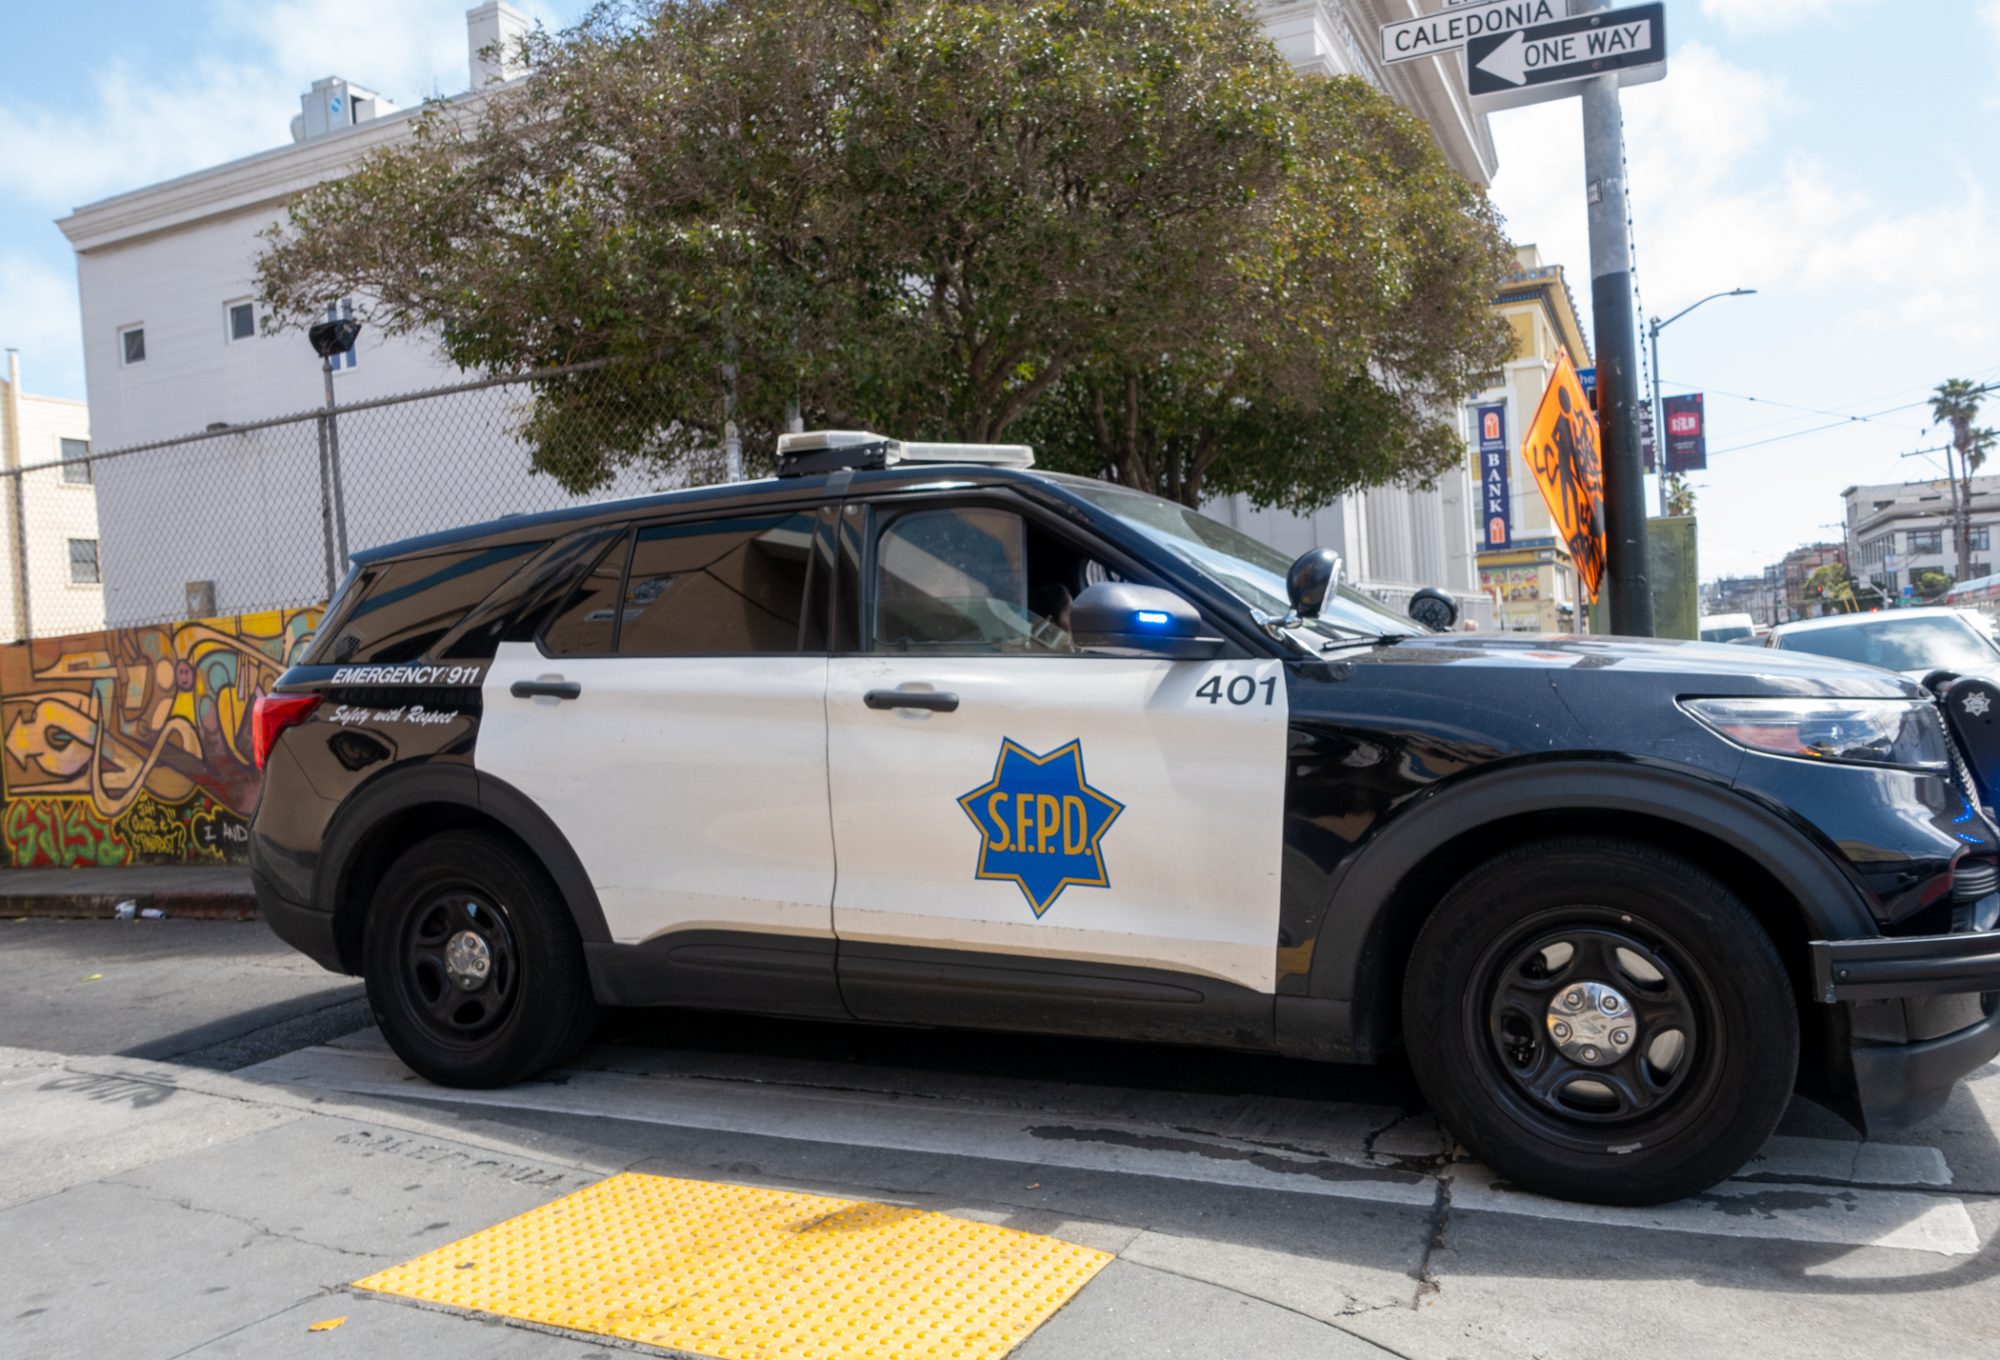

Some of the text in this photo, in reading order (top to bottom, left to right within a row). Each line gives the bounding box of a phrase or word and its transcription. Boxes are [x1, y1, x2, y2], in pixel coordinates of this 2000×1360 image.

[1395, 0, 1553, 51] CALEDONIA
[1524, 25, 1641, 67] ONE WAY
[1487, 453, 1504, 513] BANK
[331, 666, 480, 684] EMERGENCY 911
[1195, 675, 1278, 706] 401
[329, 704, 458, 727] Safety with Respect
[223, 822, 248, 842] AND
[988, 791, 1093, 856] S.F.P.D.
